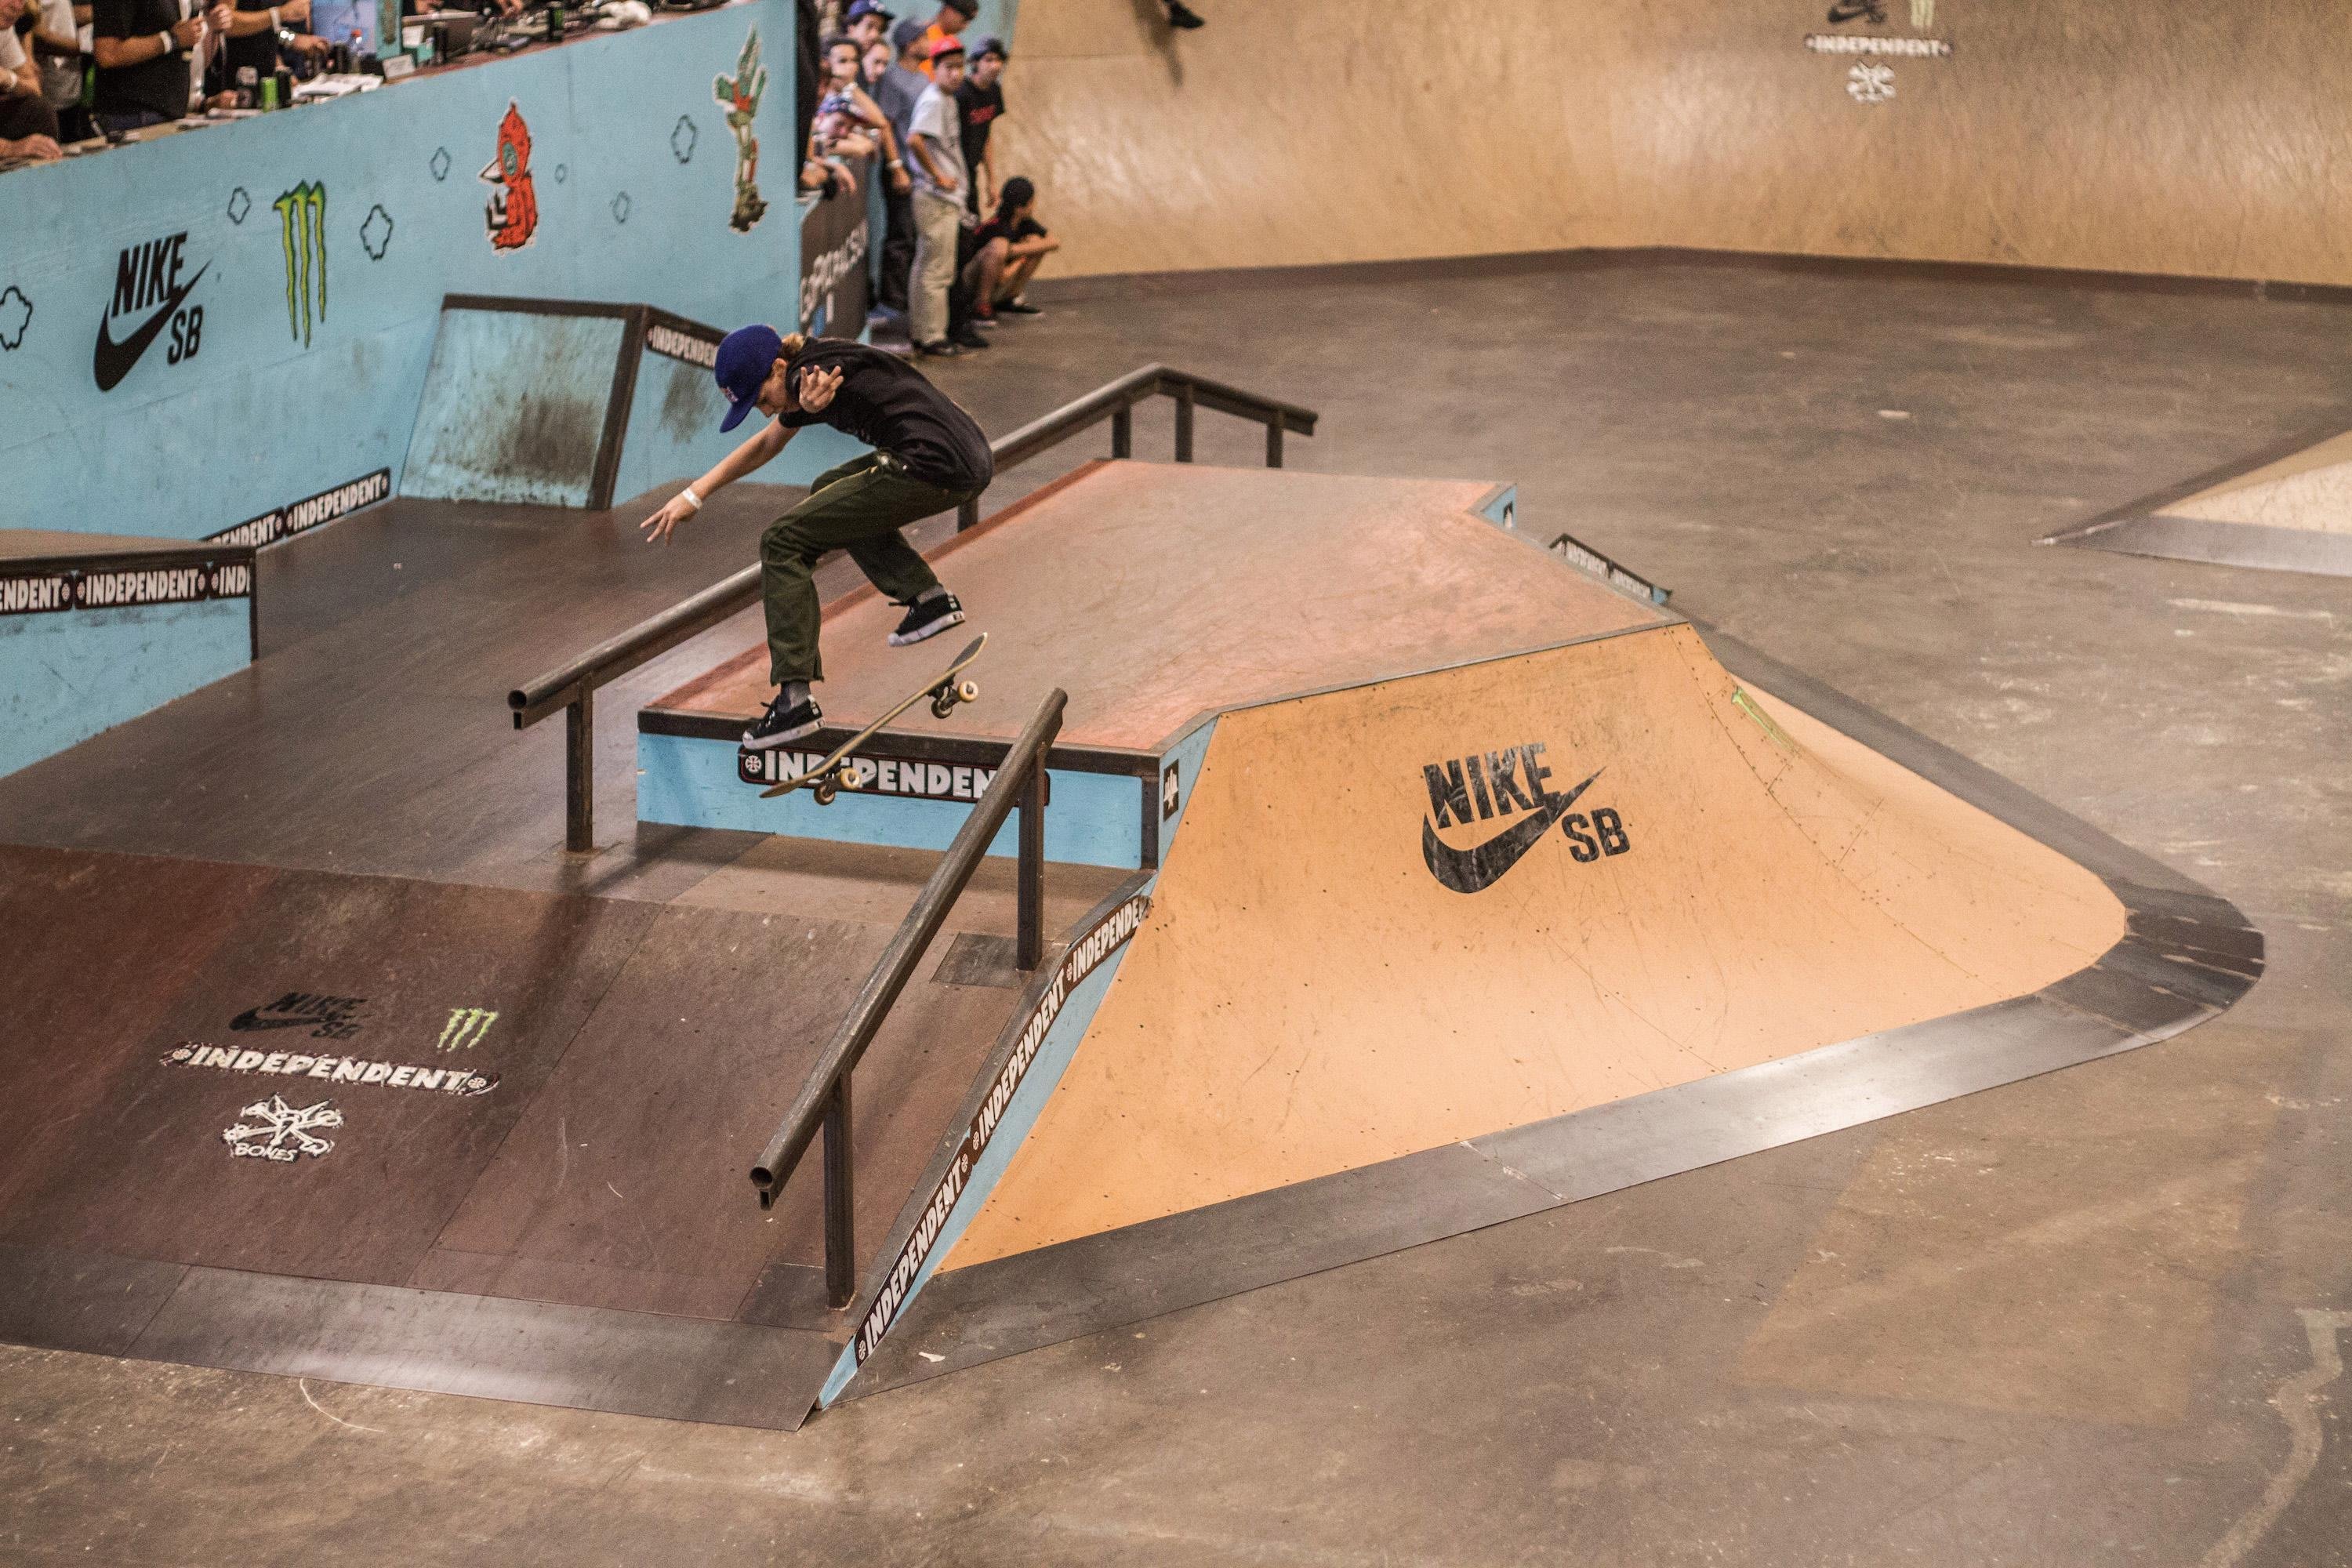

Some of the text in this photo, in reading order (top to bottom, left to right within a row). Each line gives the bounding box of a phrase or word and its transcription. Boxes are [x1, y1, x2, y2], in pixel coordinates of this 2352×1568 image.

[111, 231, 188, 318] NIKE
[167, 304, 204, 365] SB
[292, 472, 383, 532] INDEPENDENT
[85, 568, 198, 605] INDEPENDENT
[1423, 742, 1561, 829] NIKE
[1561, 807, 1631, 863] SB
[188, 1045, 473, 1091] INDEPENDENT
[235, 1142, 298, 1161] BONES
[864, 1156, 964, 1356] INDEPENDENT
[978, 968, 1065, 1147] INDEPENDENT
